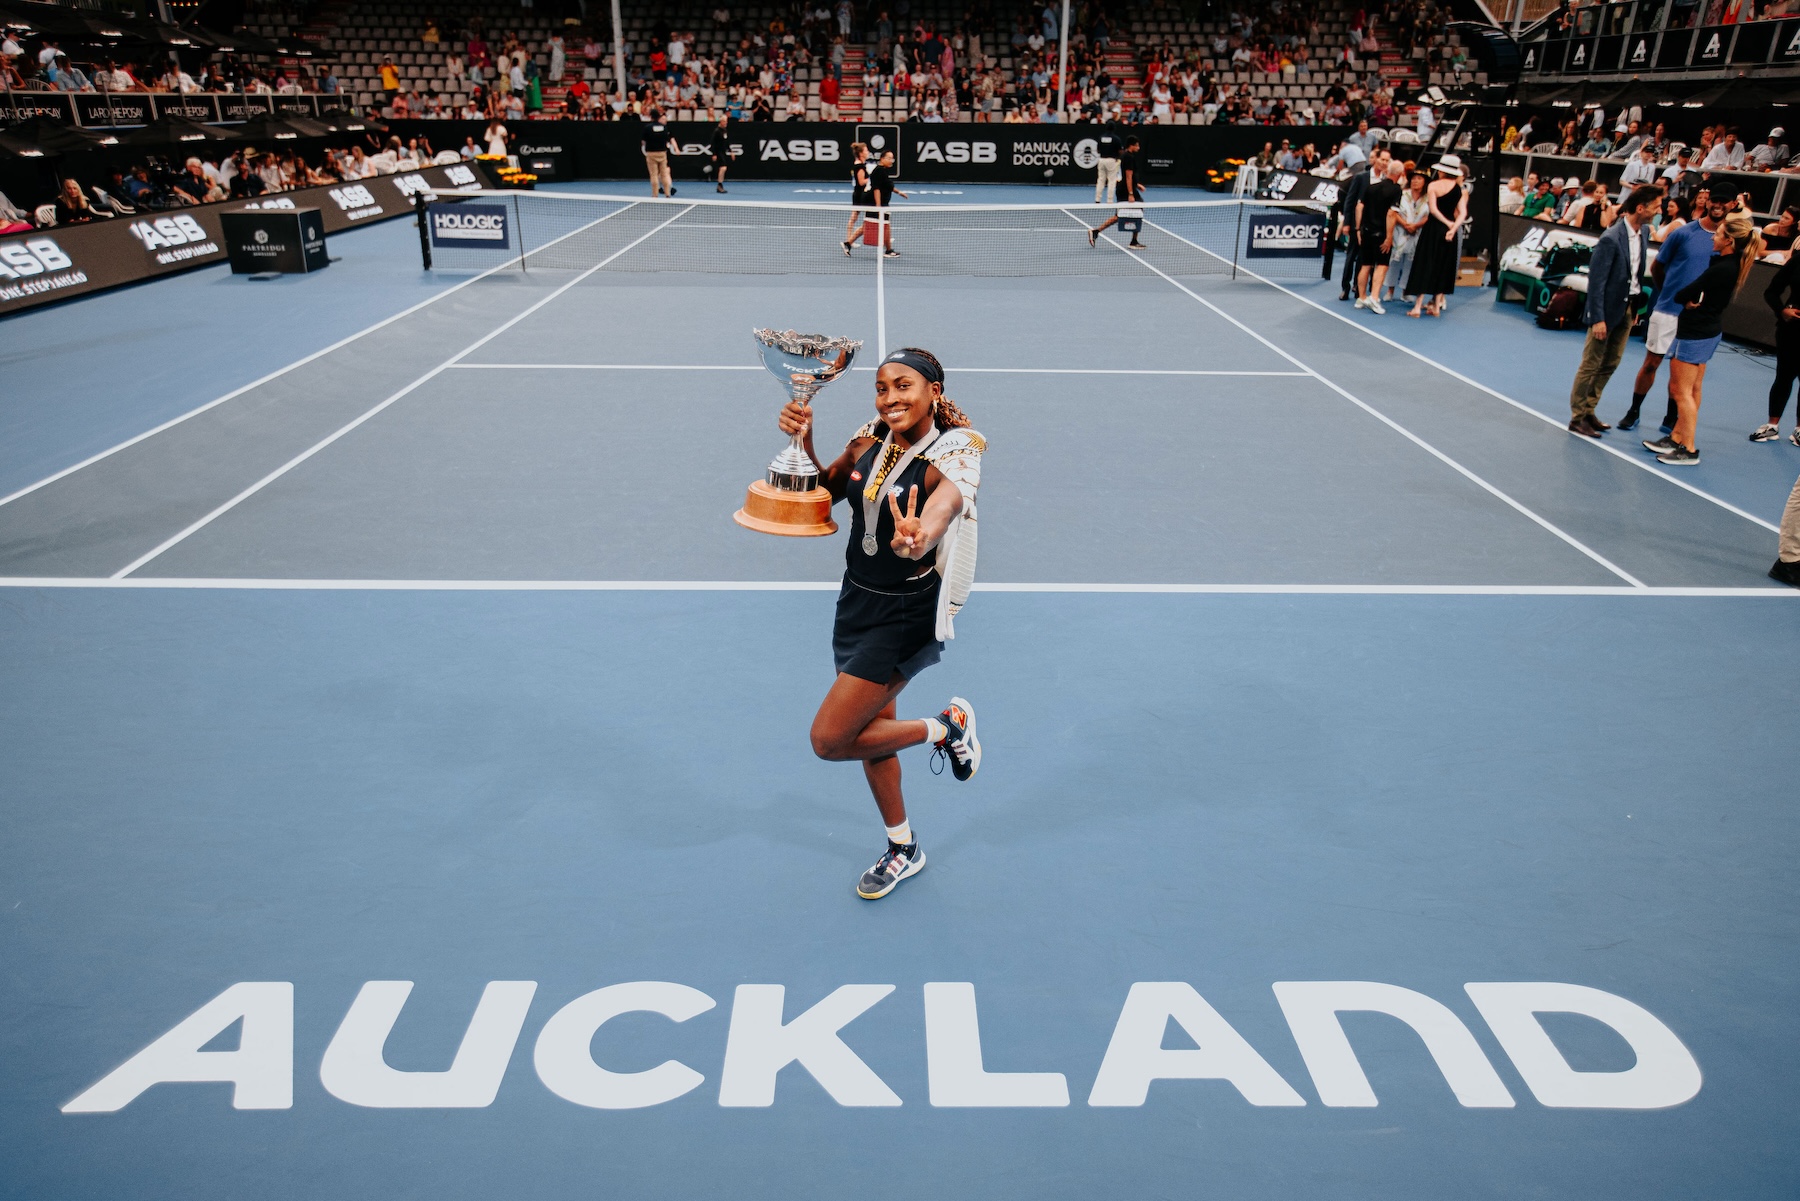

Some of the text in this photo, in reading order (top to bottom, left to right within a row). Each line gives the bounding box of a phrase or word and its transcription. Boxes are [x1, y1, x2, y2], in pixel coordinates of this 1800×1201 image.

[669, 143, 744, 156] LEXS
[759, 140, 840, 161] ASB
[917, 142, 997, 163] ASB
[1013, 142, 1070, 153] MANUKA
[1013, 154, 1069, 166] DOCTOR
[435, 213, 503, 229] HOLOGIC
[130, 214, 207, 251] ASB
[1253, 225, 1320, 239] HOLOGIC
[62, 980, 1702, 1112] AUCKLAND
